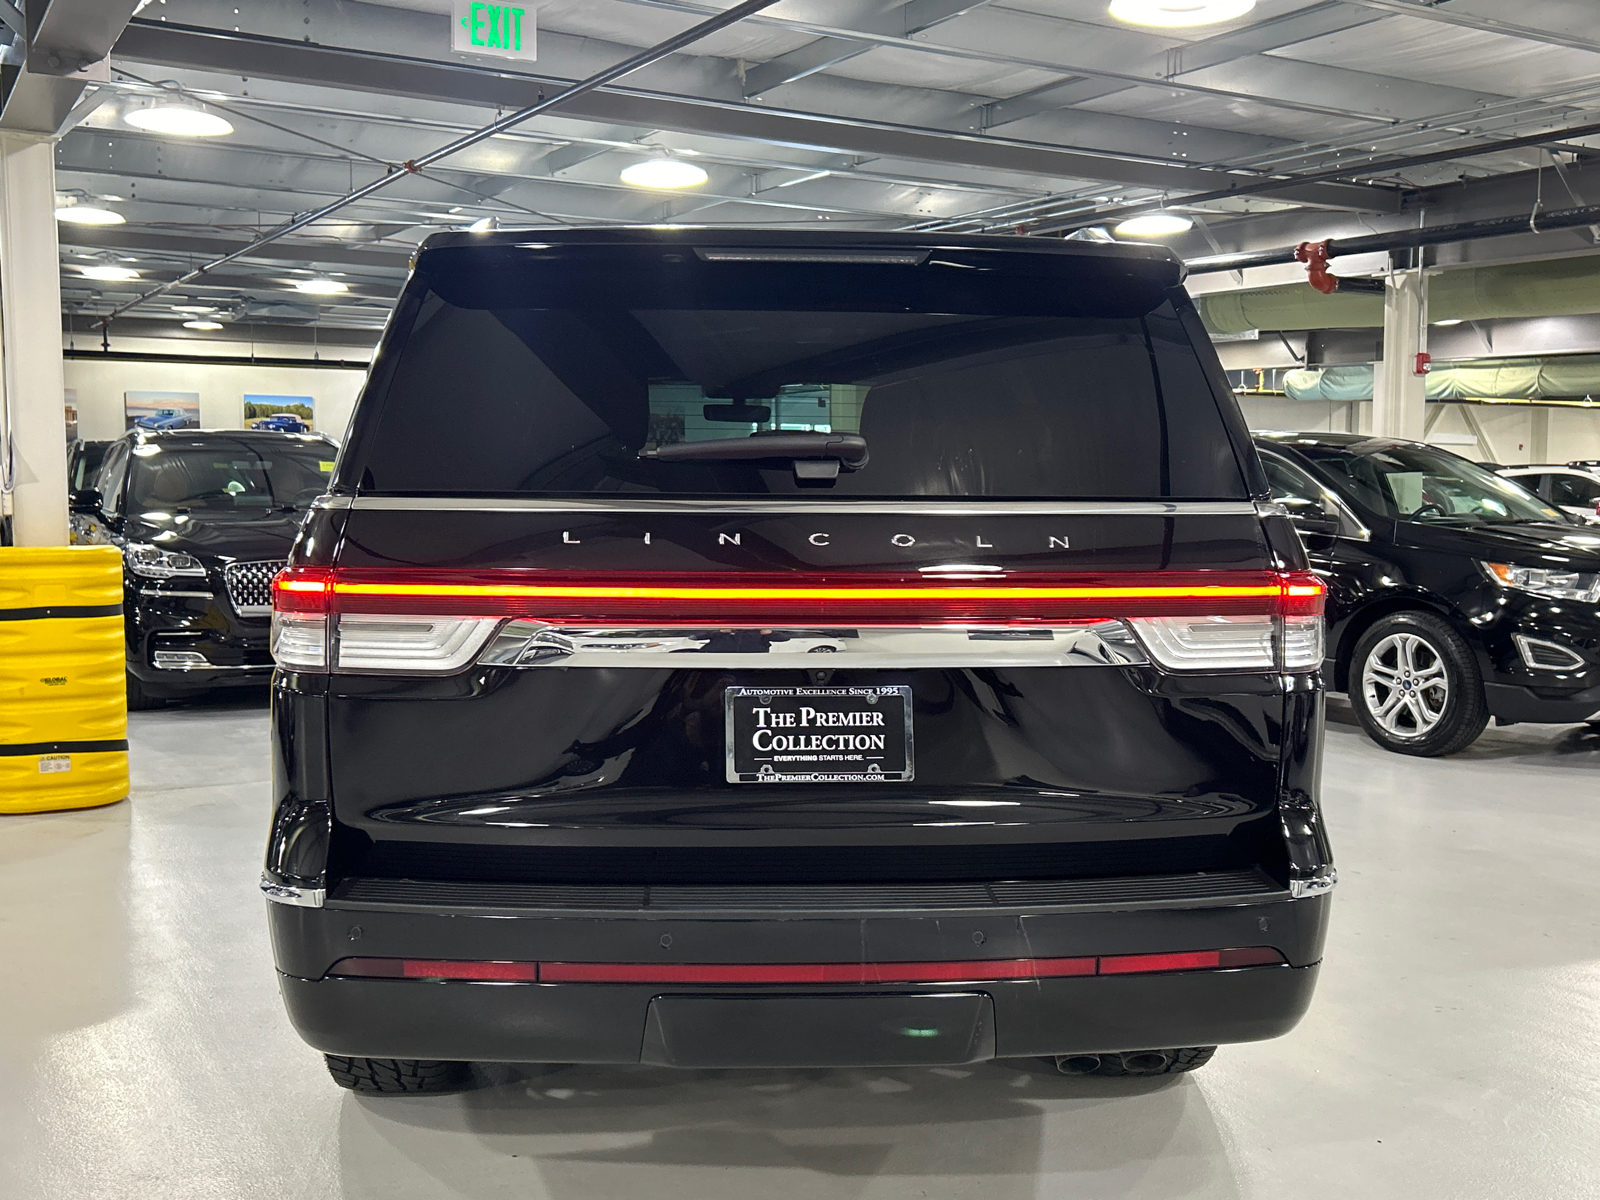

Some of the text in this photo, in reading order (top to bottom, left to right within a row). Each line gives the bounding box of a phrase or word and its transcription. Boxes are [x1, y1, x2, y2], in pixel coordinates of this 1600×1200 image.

[470, 2, 525, 51] EXIT
[562, 530, 1070, 550] LINCOLN
[876, 687, 899, 695] 1995
[752, 706, 885, 728] THE PREMIER
[752, 729, 885, 751] COLLECTION
